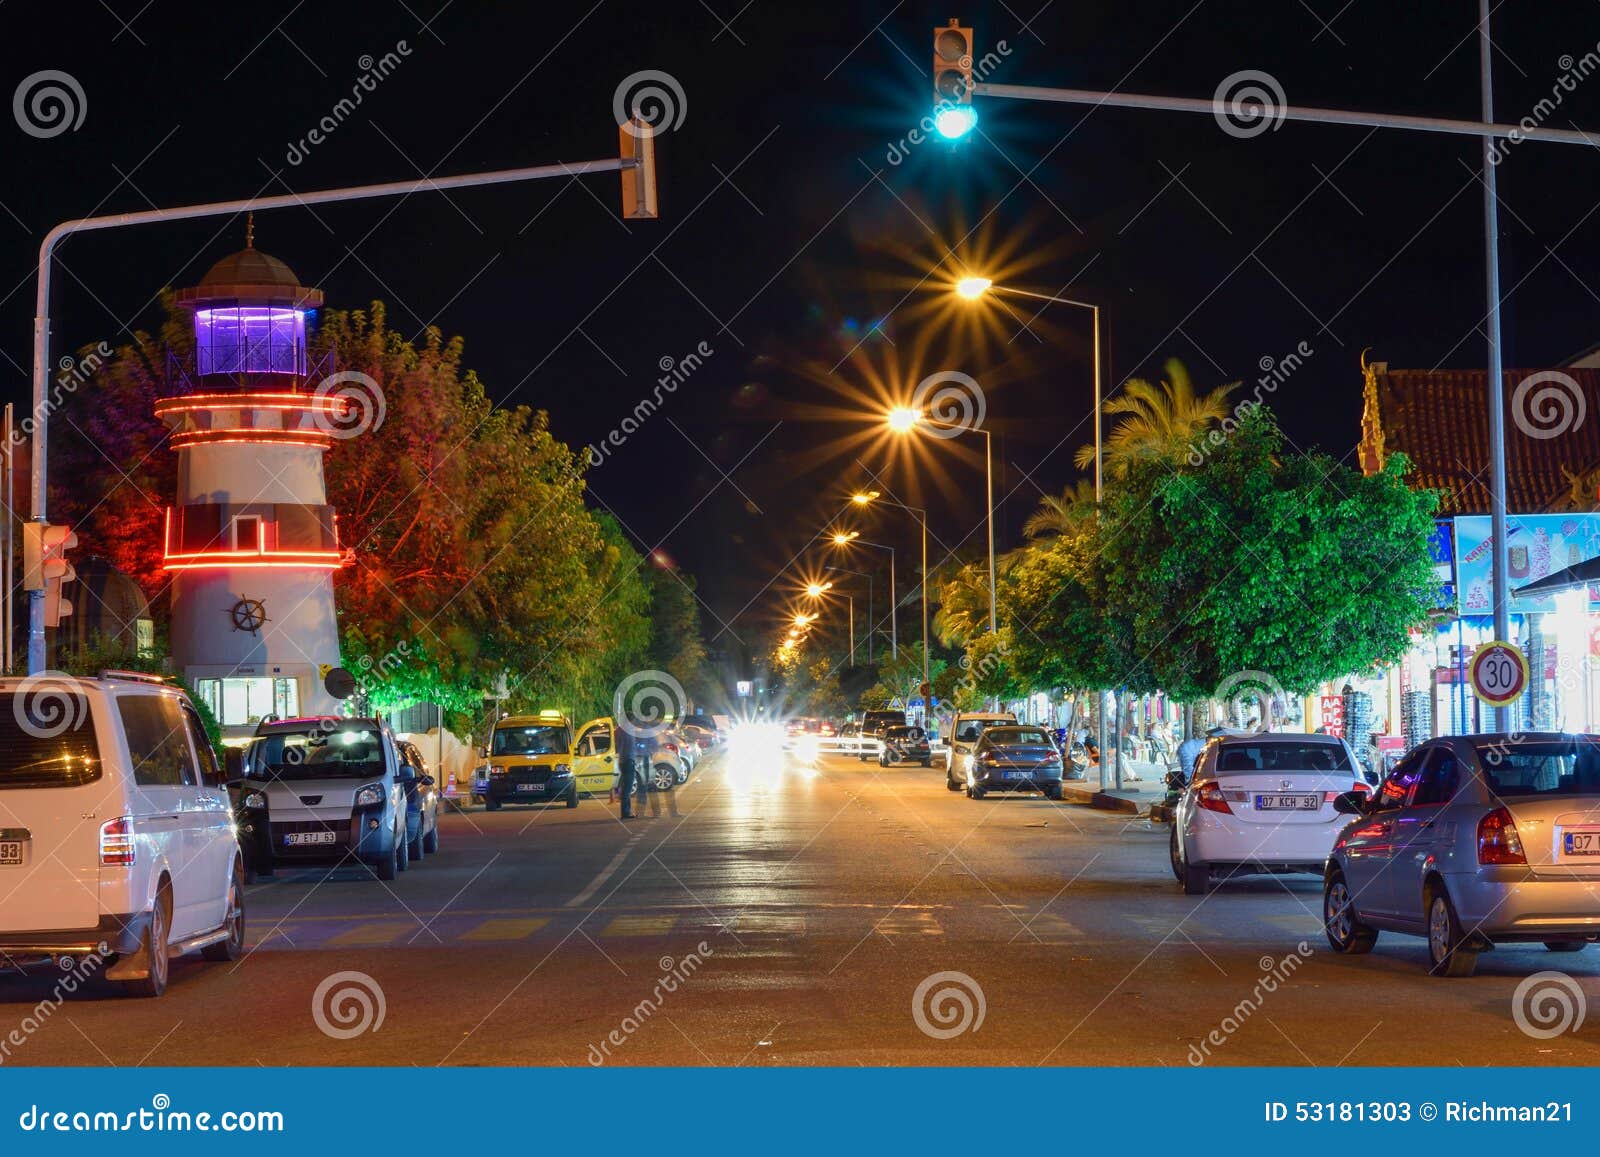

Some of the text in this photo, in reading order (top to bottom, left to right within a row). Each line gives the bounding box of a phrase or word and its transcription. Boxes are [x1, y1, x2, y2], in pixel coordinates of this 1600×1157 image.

[1486, 660, 1512, 688] 30
[1263, 797, 1315, 808] 07 KCH 92
[1574, 835, 1592, 849] 07
[0, 843, 18, 859] 93
